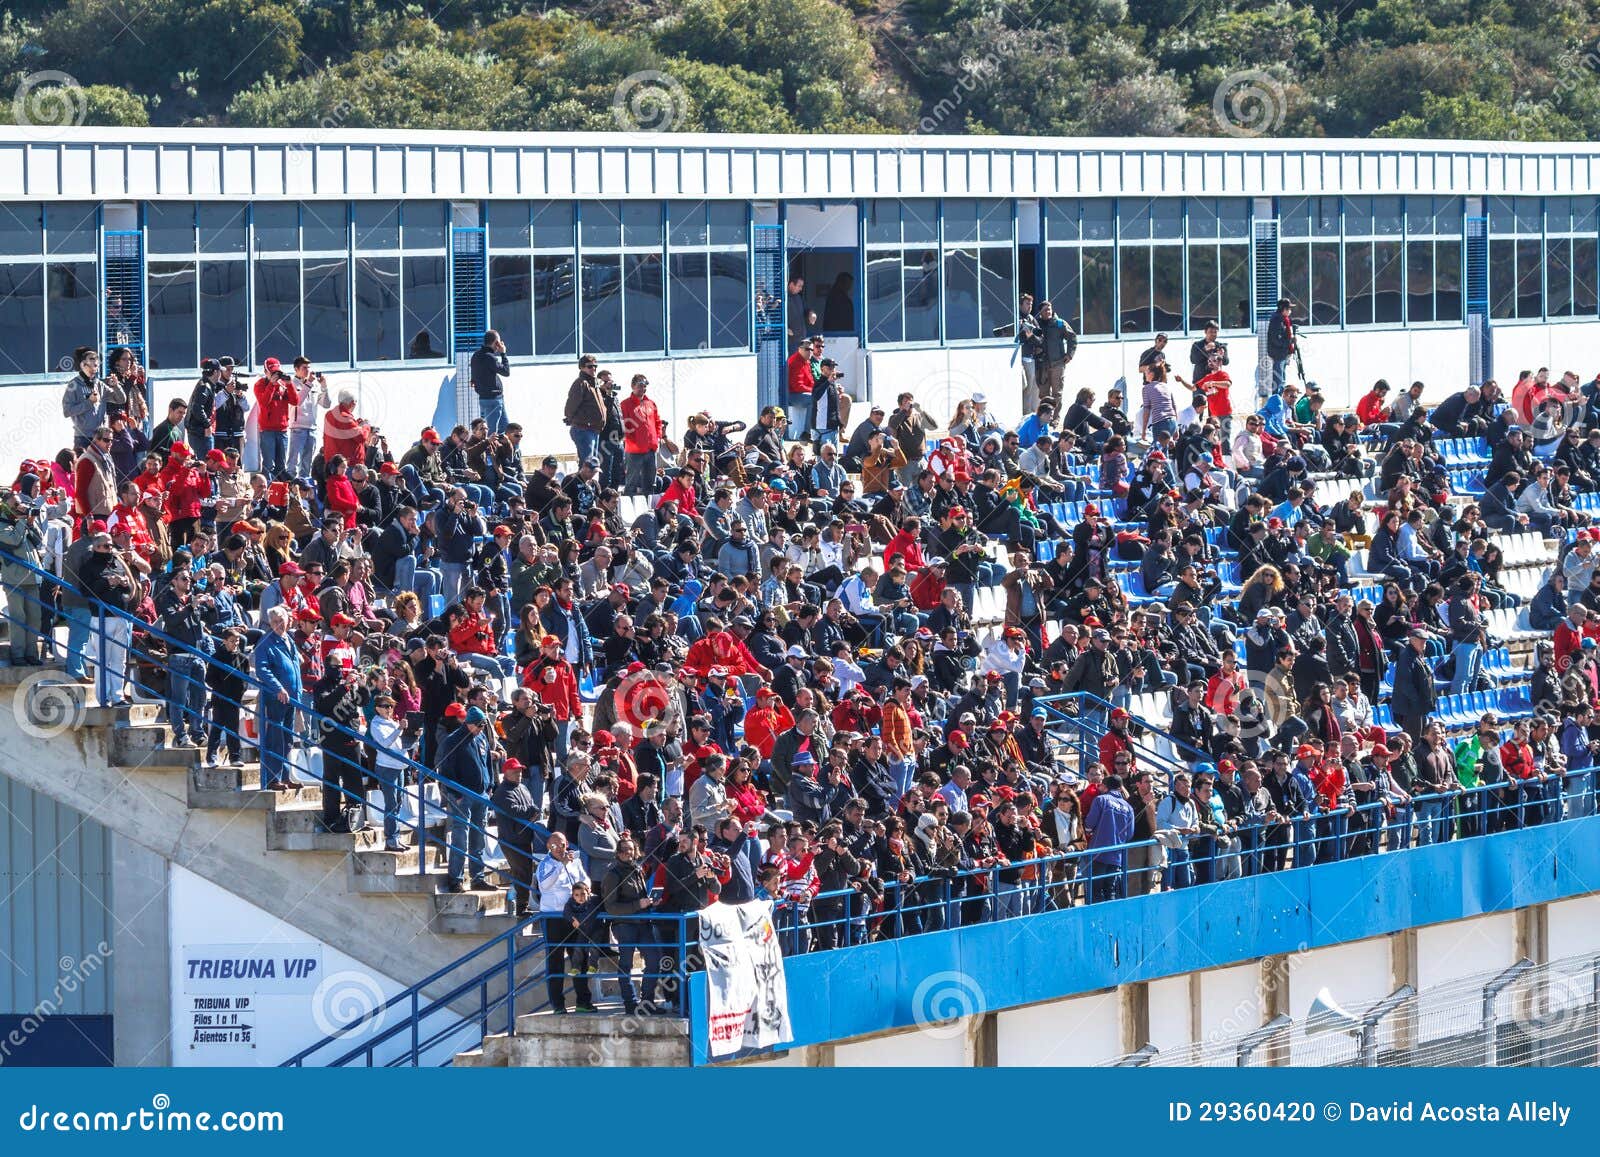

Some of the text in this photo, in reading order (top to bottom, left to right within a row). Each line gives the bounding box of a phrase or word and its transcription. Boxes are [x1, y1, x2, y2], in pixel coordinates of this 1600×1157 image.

[187, 959, 317, 979] TRIBUNA VIP
[193, 998, 250, 1009] TRIBUNA VIP
[193, 1013, 237, 1025] Filas 1 a 11
[229, 1031, 233, 1042] 1
[234, 1033, 239, 1042] a
[241, 1031, 251, 1042] 36
